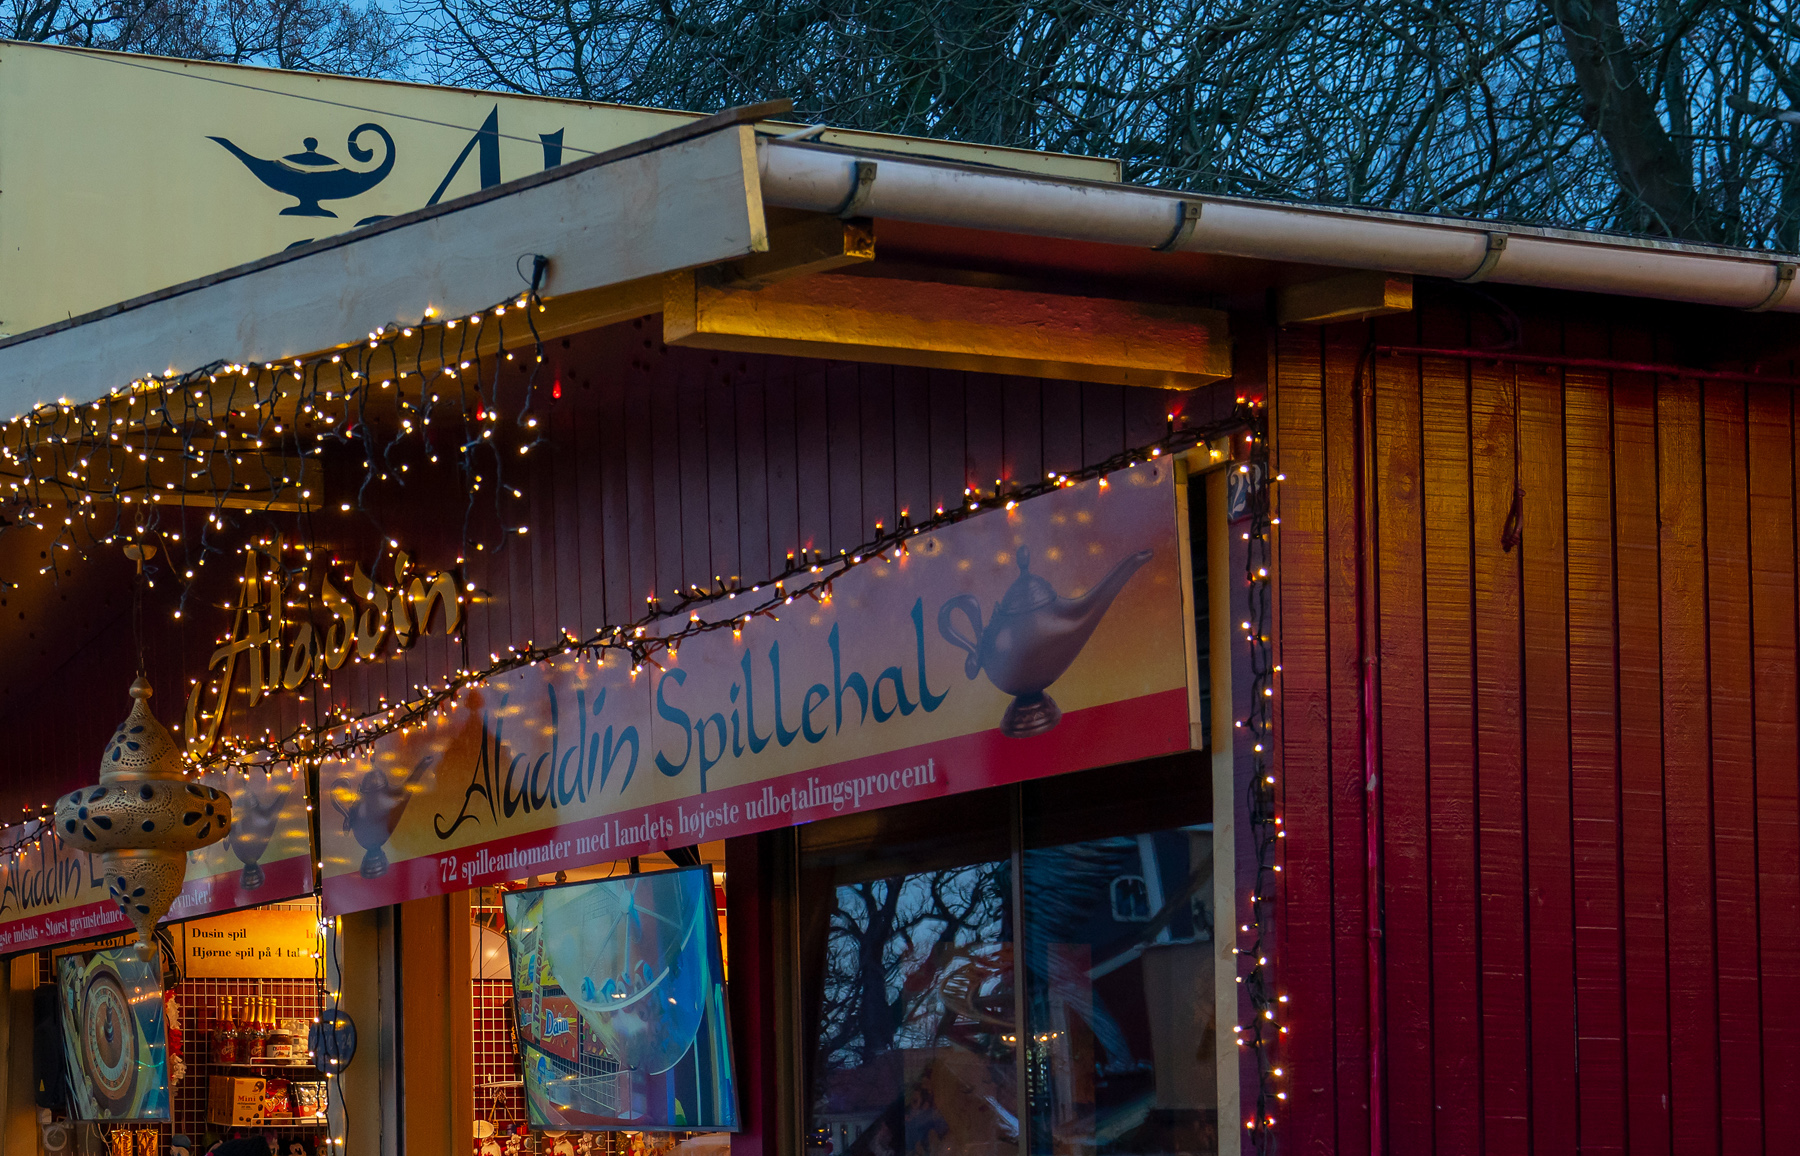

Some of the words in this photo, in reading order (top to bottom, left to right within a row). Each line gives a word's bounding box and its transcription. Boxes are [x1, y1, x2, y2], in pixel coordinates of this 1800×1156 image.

[433, 677, 640, 840] Aladdin
[654, 596, 951, 794] Spillehal
[439, 855, 458, 883] 72
[461, 839, 571, 886] spilleautomater
[576, 822, 610, 855] med
[614, 813, 674, 847] landets
[678, 801, 740, 839] højeste
[745, 757, 937, 821] udbetalingsprocent
[12, 922, 39, 942] indsats
[45, 917, 69, 937] Størst
[192, 928, 224, 939] Dusin
[227, 928, 247, 941] spil
[192, 946, 232, 959] Hjørne
[235, 947, 255, 960] spil
[258, 947, 272, 960] på
[274, 948, 282, 957] 4
[286, 947, 300, 958] tal
